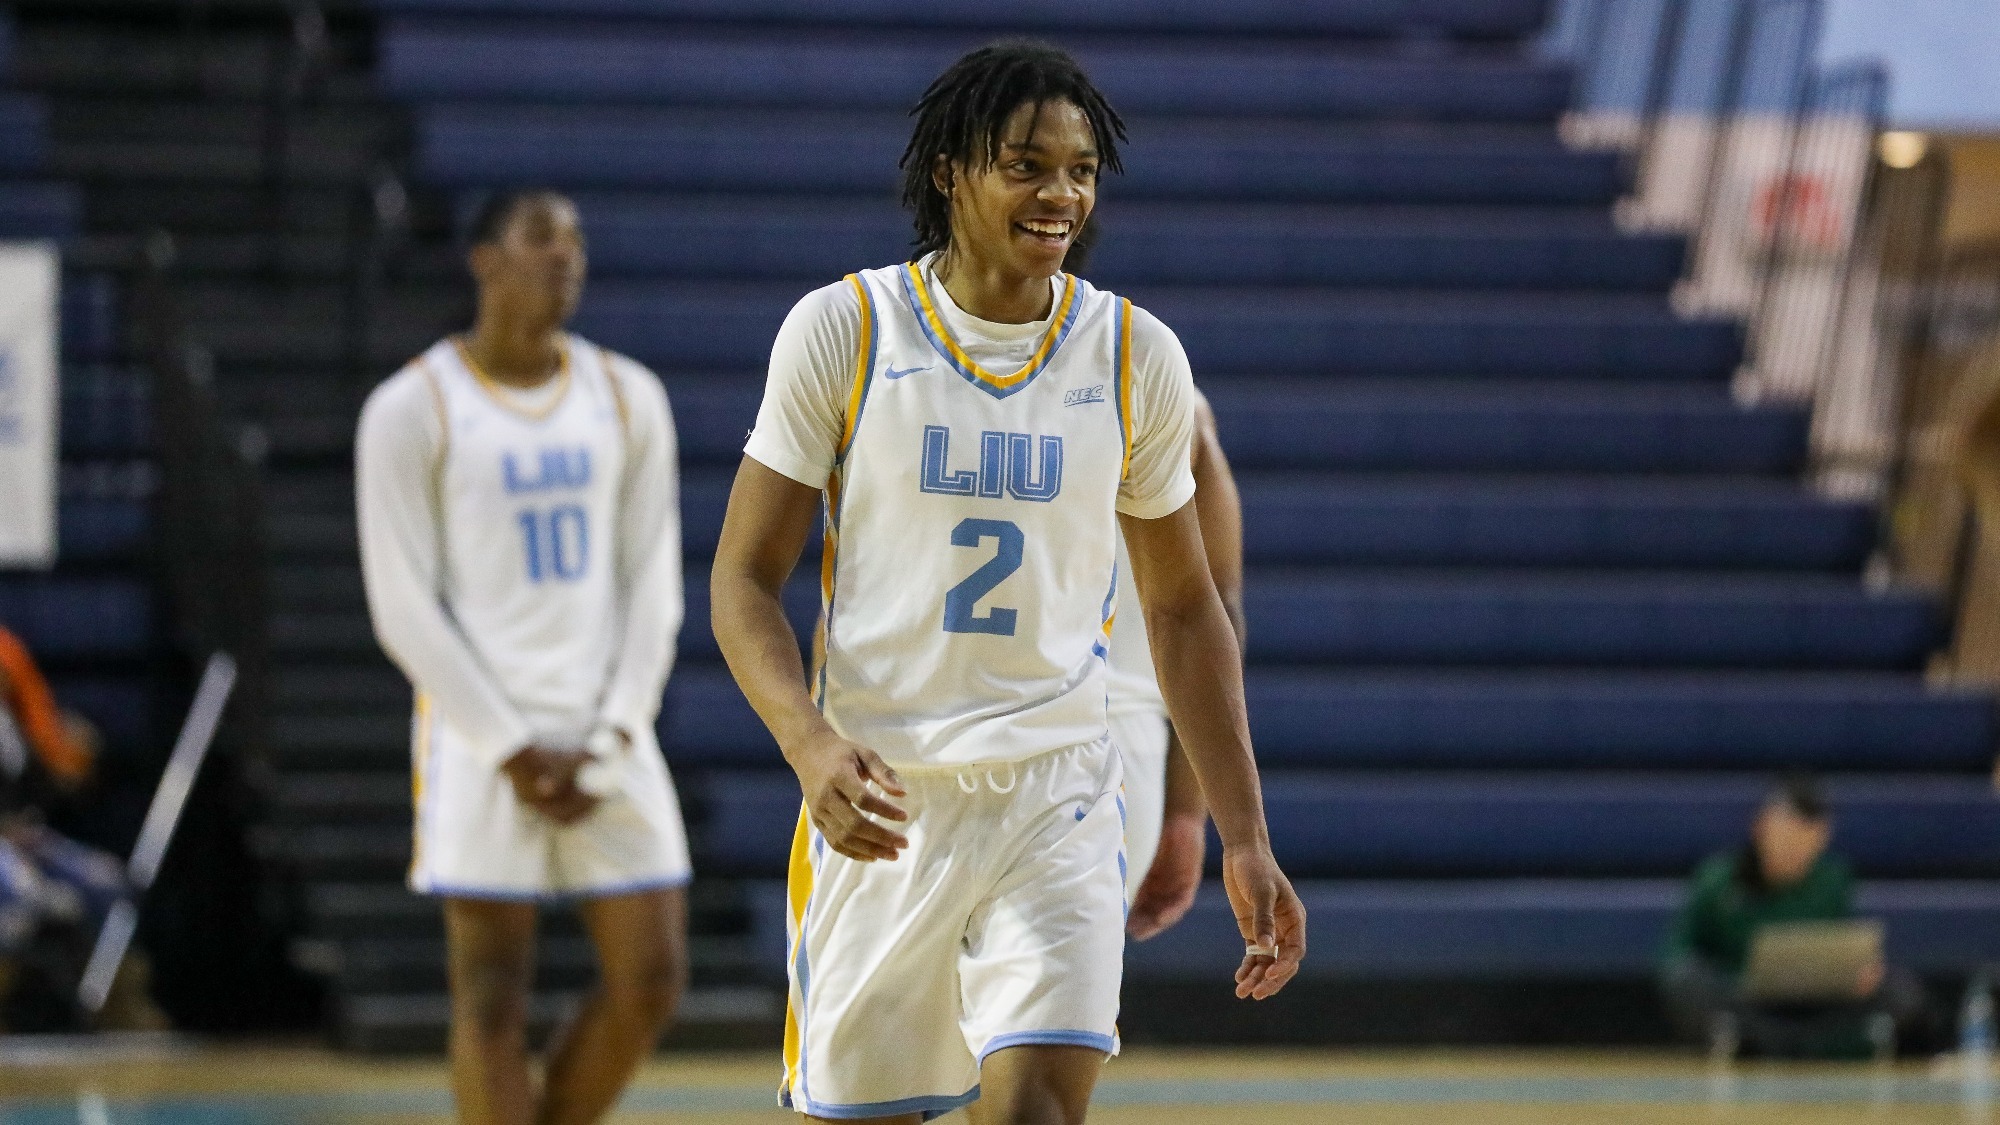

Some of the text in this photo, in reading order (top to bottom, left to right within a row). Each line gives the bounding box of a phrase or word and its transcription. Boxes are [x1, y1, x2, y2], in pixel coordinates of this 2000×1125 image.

[1064, 385, 1103, 403] NEC
[502, 447, 593, 492] LIU
[920, 425, 1063, 502] LIU
[517, 505, 590, 583] 10
[943, 518, 1024, 636] 2
